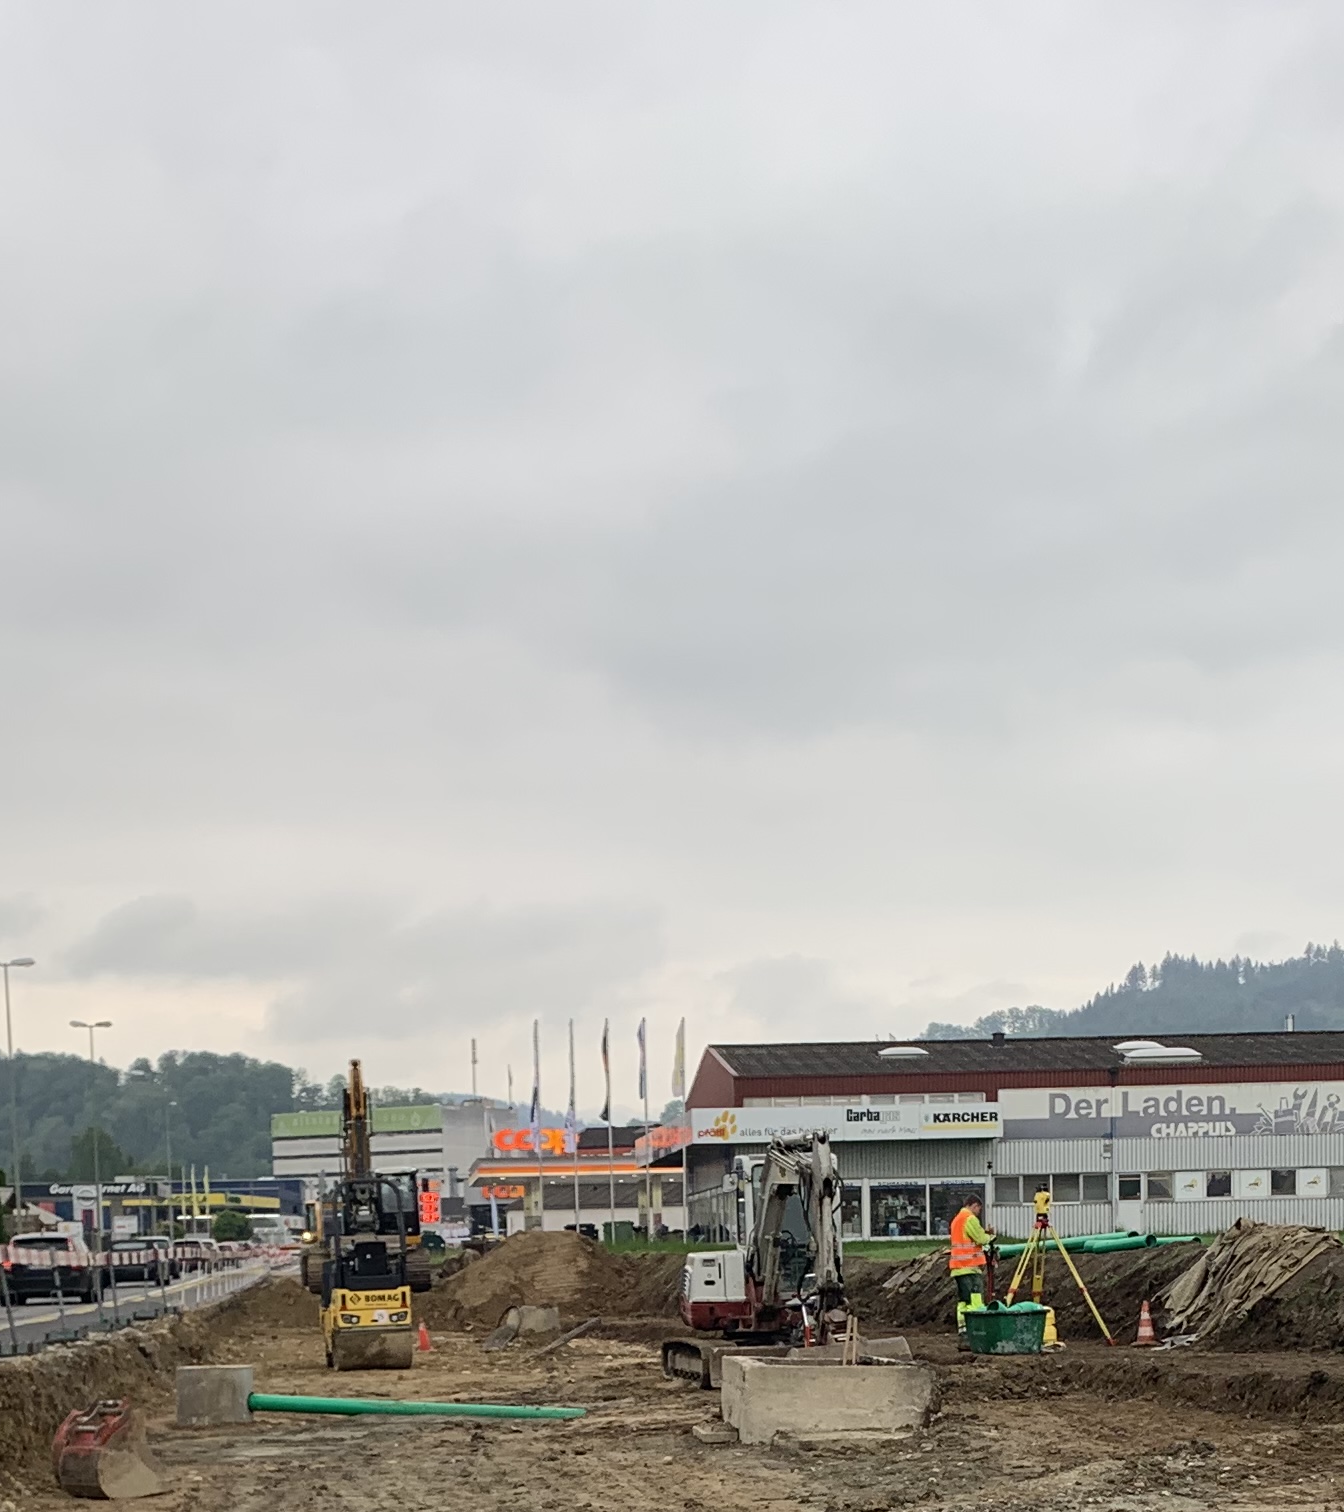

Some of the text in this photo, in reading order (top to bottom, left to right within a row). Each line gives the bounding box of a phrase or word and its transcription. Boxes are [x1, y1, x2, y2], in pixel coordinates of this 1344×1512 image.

[1049, 1089, 1237, 1120] Der Laden.
[739, 1127, 763, 1137] alles
[780, 1127, 798, 1136] das
[1150, 1121, 1237, 1138] CHAPPUIS
[364, 1294, 400, 1302] BOMAG
